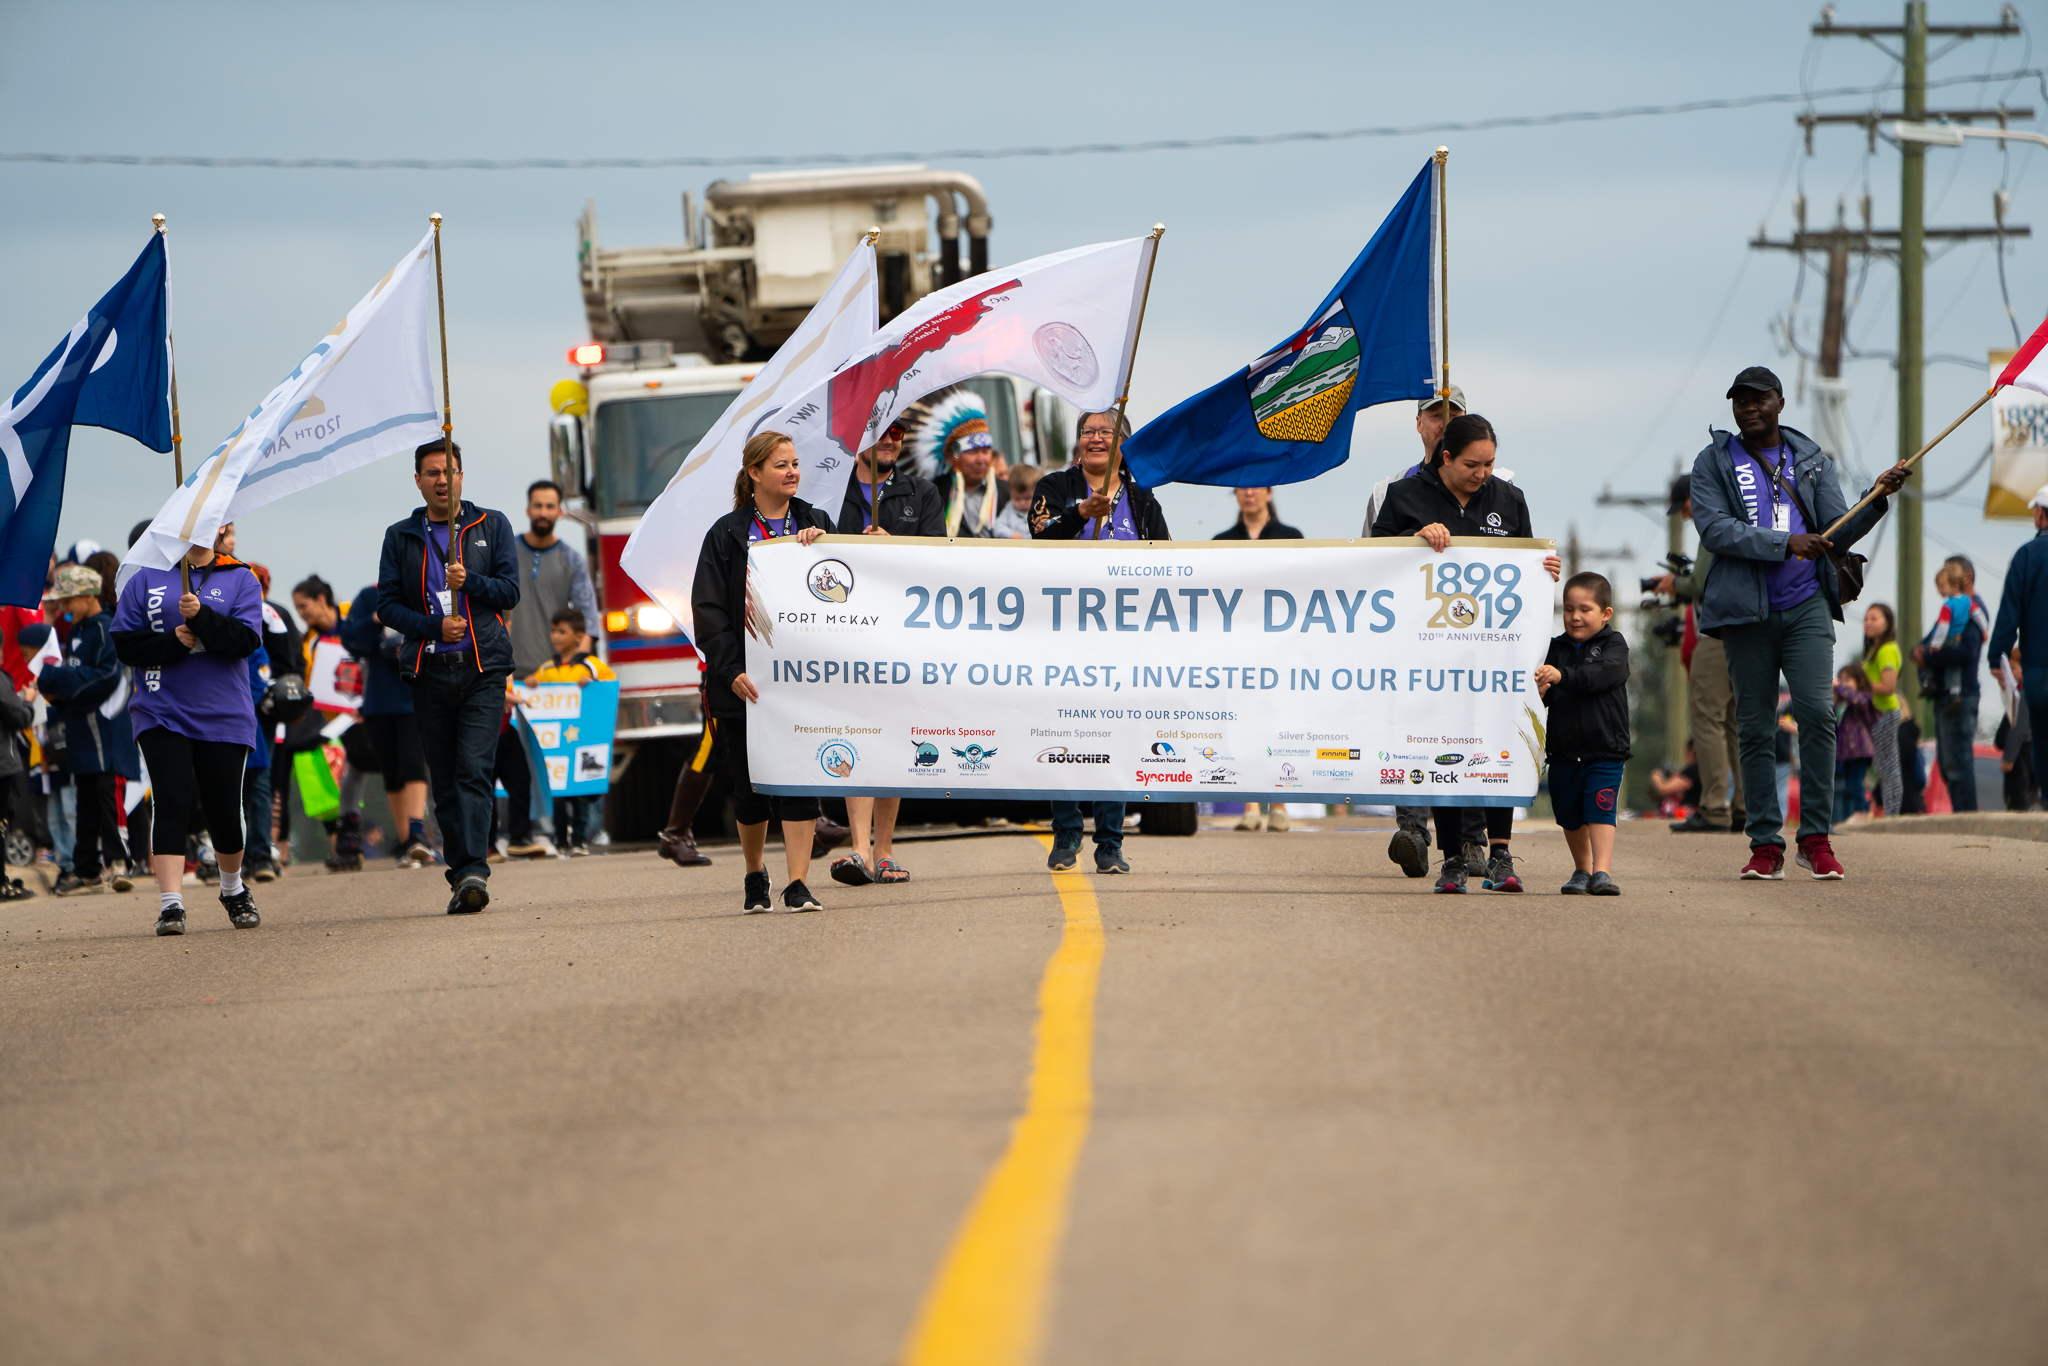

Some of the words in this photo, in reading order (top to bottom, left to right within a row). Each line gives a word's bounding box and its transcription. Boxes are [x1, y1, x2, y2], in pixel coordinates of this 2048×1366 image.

[1107, 565, 1173, 577] WELCOME
[1176, 566, 1193, 577] TO
[1420, 562, 1521, 599] 1899
[903, 585, 1025, 631] 2019
[1041, 587, 1244, 632] TREATY
[1263, 589, 1396, 633] DAYS
[1427, 592, 1522, 629] 2019
[778, 612, 817, 624] FORT
[145, 576, 168, 693] VOLUER
[1418, 632, 1444, 641] 120TH
[1446, 632, 1522, 642] ANNIVERSARY
[773, 660, 911, 685] INSPIRED
[922, 662, 958, 685] BY
[967, 663, 1033, 687] OUR
[1045, 664, 1121, 692] PAST,
[1132, 665, 1279, 690] INVESTED
[1290, 668, 1320, 691] IN
[1331, 668, 1397, 691] OUR
[1409, 669, 1526, 693] FUTURE
[1058, 709, 1096, 719] THANK
[1100, 709, 1123, 719] YOU
[1127, 710, 1141, 719] TO
[1145, 710, 1170, 720] OUR
[1173, 711, 1238, 721] SPONSORS:
[794, 725, 842, 736] Presenting
[845, 726, 882, 736] Sponsor
[911, 727, 955, 736] Fireworks
[958, 728, 995, 738] Sponsor
[1030, 729, 1071, 738] Platinum
[1074, 729, 1112, 739] Sponsor
[1156, 730, 1179, 739] Gold
[1180, 730, 1223, 740] Sponsors
[1279, 732, 1304, 740] Silver
[1306, 732, 1349, 742] Sponsors
[1406, 735, 1439, 744] Bronze
[1441, 736, 1483, 745] Sponsors
[1349, 750, 1360, 758] CAT
[1135, 770, 1193, 786] Syncrude
[1429, 771, 1458, 784] Teck
